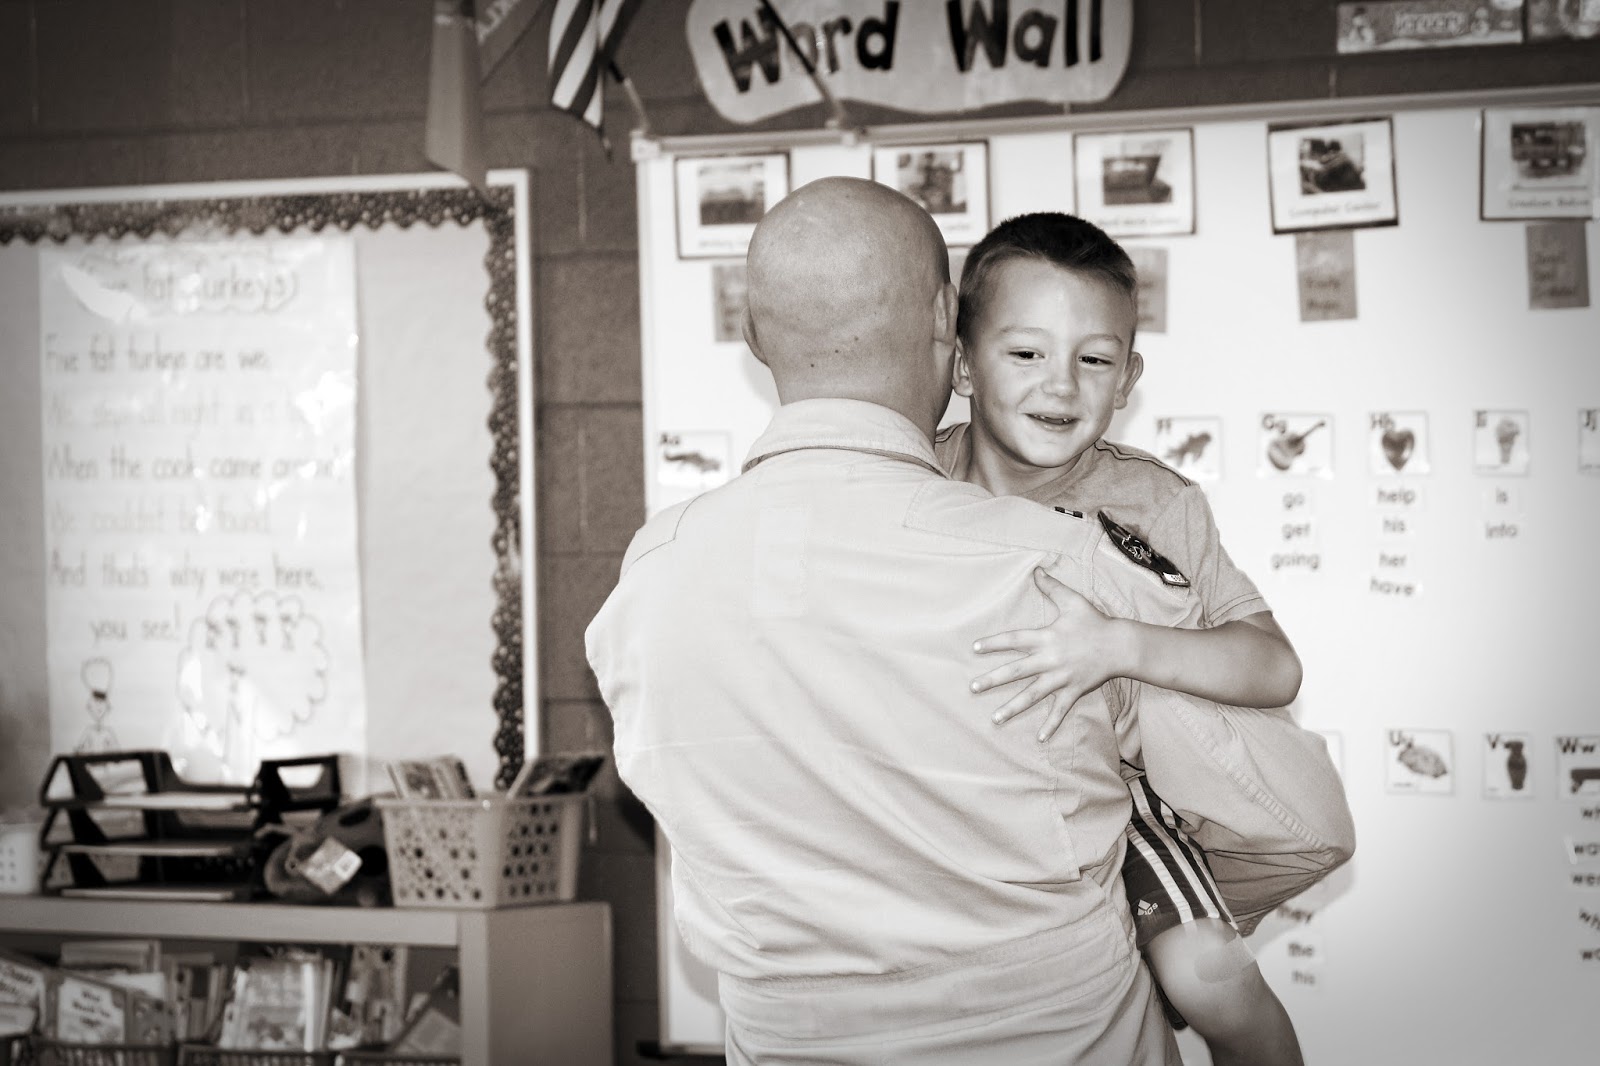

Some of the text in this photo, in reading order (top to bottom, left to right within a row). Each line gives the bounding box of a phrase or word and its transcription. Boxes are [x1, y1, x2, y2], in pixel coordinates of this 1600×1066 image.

[713, 0, 1102, 93] Word Wall
[1261, 413, 1288, 435] Gg
[1281, 492, 1306, 510] go
[1376, 488, 1416, 505] help
[1281, 523, 1311, 541] get
[1382, 517, 1406, 533] his
[1485, 520, 1518, 539] into
[1271, 553, 1321, 571] going
[1369, 576, 1415, 597] have
